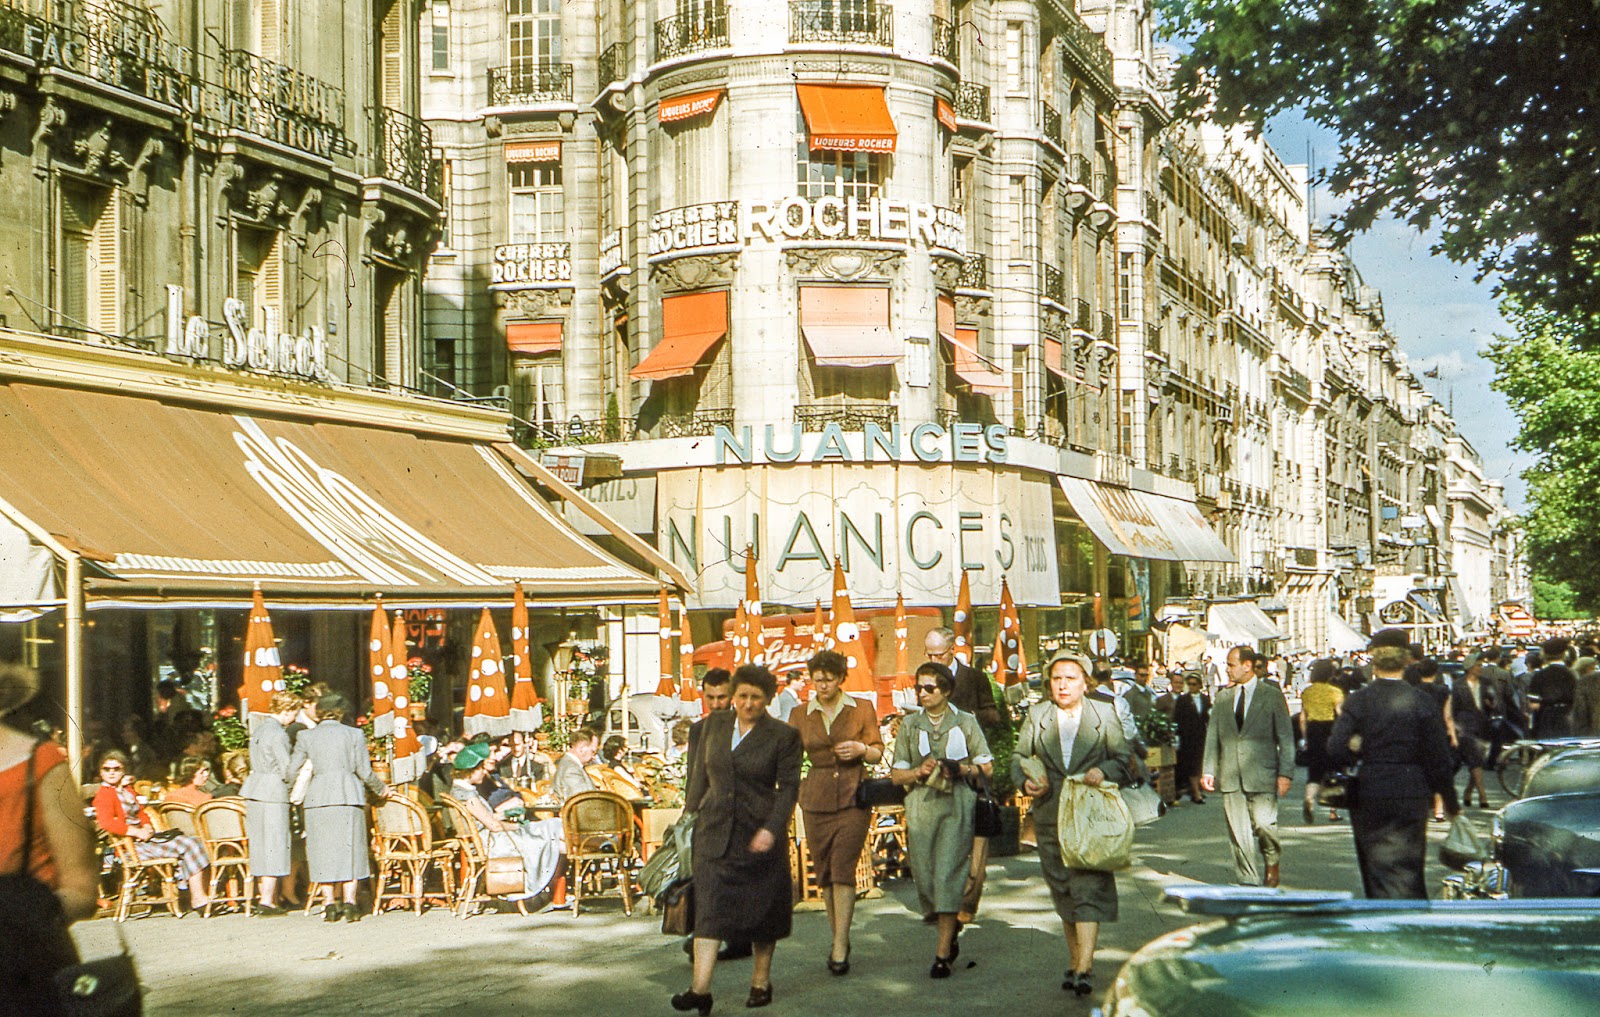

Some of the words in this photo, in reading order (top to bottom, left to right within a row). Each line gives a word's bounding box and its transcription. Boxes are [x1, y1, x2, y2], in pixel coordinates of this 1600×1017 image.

[814, 137, 856, 148] LIQUEURS
[858, 138, 894, 149] ROCHER
[743, 196, 937, 242] ROCHER
[495, 244, 567, 261] CHERRY
[648, 220, 737, 254] ROCHER
[492, 260, 572, 282] ROCHER
[714, 422, 1010, 465] NUANCES
[668, 511, 1016, 575] NUANCES
